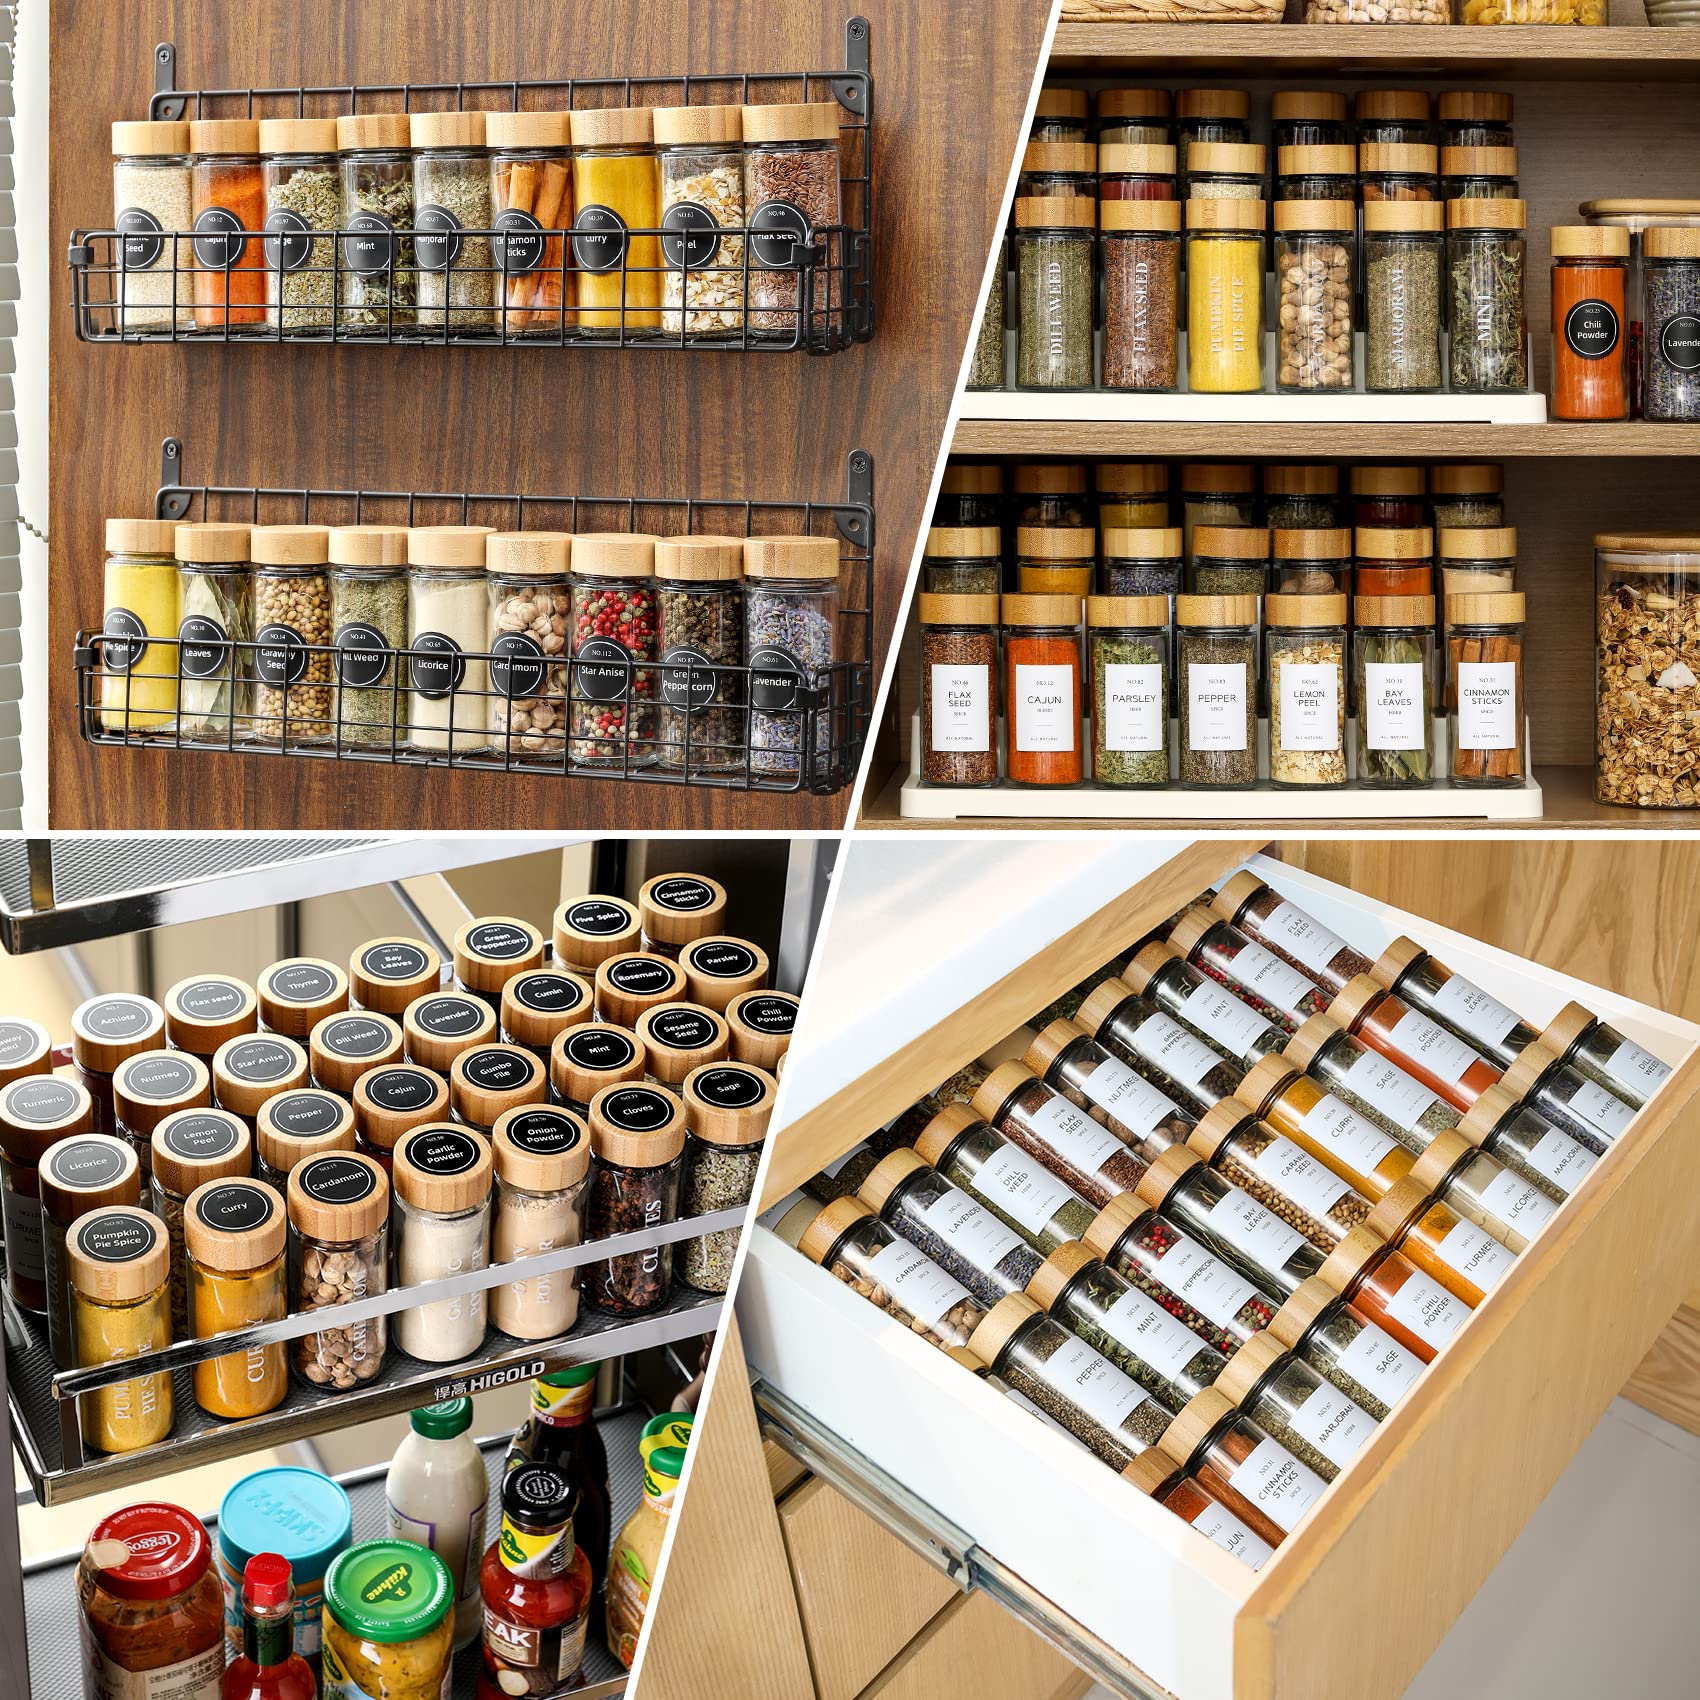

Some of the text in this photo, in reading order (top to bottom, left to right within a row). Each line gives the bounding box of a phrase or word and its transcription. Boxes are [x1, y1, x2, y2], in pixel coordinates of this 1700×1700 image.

[356, 242, 375, 250] Mint
[585, 235, 608, 244] Curry
[125, 244, 143, 252] Seed
[507, 248, 526, 256] ticks
[1050, 262, 1062, 312] WEED
[1210, 276, 1224, 353] PUMPKIN
[1232, 276, 1244, 352] PIE SPICE
[1392, 268, 1404, 364] MARJORAM
[1478, 295, 1492, 341] MINT
[1584, 320, 1602, 329] Chili
[1577, 331, 1608, 339] Powder
[185, 649, 212, 658] Leaves
[418, 660, 449, 670] Licorice
[581, 666, 624, 676] Star Anise
[663, 680, 713, 692] Peppecorn
[1464, 688, 1510, 696] CINNAMON
[1028, 696, 1062, 704] CAJUN
[1112, 694, 1156, 702] PARSLEY
[660, 888, 704, 898] Cinnamon
[674, 895, 700, 904] Sticks
[576, 912, 620, 924] Five Spice
[1288, 918, 1303, 934] FLAX
[1294, 922, 1309, 937] SEED
[475, 938, 526, 951] Peppercorn
[484, 934, 510, 942] Green
[380, 960, 412, 969] Leaves
[706, 954, 738, 964] Parsley
[617, 970, 662, 982] Rosemary
[288, 978, 320, 991] Thyme
[534, 988, 564, 998] Cumin
[1464, 992, 1476, 1004] BAY
[190, 994, 234, 1008] Flax seed
[1210, 1000, 1230, 1020] MINT
[100, 1013, 136, 1026] Achiote
[428, 1009, 470, 1025] Lavender
[756, 1015, 793, 1023] Powder
[664, 1021, 700, 1032] Sesame
[336, 1030, 378, 1046] Dill Weed
[674, 1028, 698, 1039] Seed
[1163, 1028, 1180, 1043] GREEN
[1418, 1027, 1434, 1042] CHILI
[588, 1045, 610, 1054] Mint
[236, 1054, 284, 1069] Star Anise
[1638, 1057, 1652, 1070] DILL
[480, 1061, 512, 1076] Gumbo
[493, 1070, 511, 1080] File
[140, 1070, 180, 1084] Nutmeg
[1376, 1070, 1396, 1090] SAGE
[388, 1084, 416, 1096] Cajun
[716, 1082, 742, 1094] Sage
[1108, 1075, 1140, 1104] NUTMEG
[22, 1096, 65, 1110] Turmeric
[288, 1108, 324, 1122] Pepper
[622, 1104, 654, 1116] Cloves
[1058, 1114, 1078, 1130] FLAX
[1066, 1120, 1084, 1135] SEED
[1331, 1114, 1355, 1138] CURRY
[184, 1128, 218, 1140] Lemon
[528, 1126, 558, 1136] Onion
[192, 1136, 216, 1146] Peel
[526, 1133, 564, 1144] Powder
[427, 1144, 456, 1156] Garlic
[426, 1150, 464, 1164] Powder
[69, 1158, 108, 1171] Licorice
[1294, 1160, 1311, 1174] SEED
[312, 1170, 365, 1192] Cardamom
[1002, 1170, 1021, 1187] DILL
[1008, 1172, 1029, 1194] WEED
[220, 1202, 248, 1214] Curry
[1242, 1207, 1258, 1222] BAY
[1244, 1210, 1268, 1233] LEAVES
[92, 1228, 140, 1241] Pumpkin
[642, 1200, 662, 1274] CLES
[95, 1237, 142, 1249] Pie Spice
[1182, 1258, 1216, 1292] PEPPERCORN
[1421, 1294, 1440, 1316] CHILI
[1424, 1296, 1451, 1328] POWDER
[1137, 1312, 1158, 1334] MINT
[1376, 1350, 1400, 1374] SAGE
[470, 1362, 546, 1392] HIGOLD
[1076, 1358, 1104, 1386] PEPPER
[1258, 1459, 1275, 1476] NO.31
[1258, 1459, 1296, 1500] CINNAMON
[1272, 1471, 1300, 1500] STICKS
[1288, 1486, 1302, 1499] SPICE
[366, 1566, 408, 1601] Kühne
